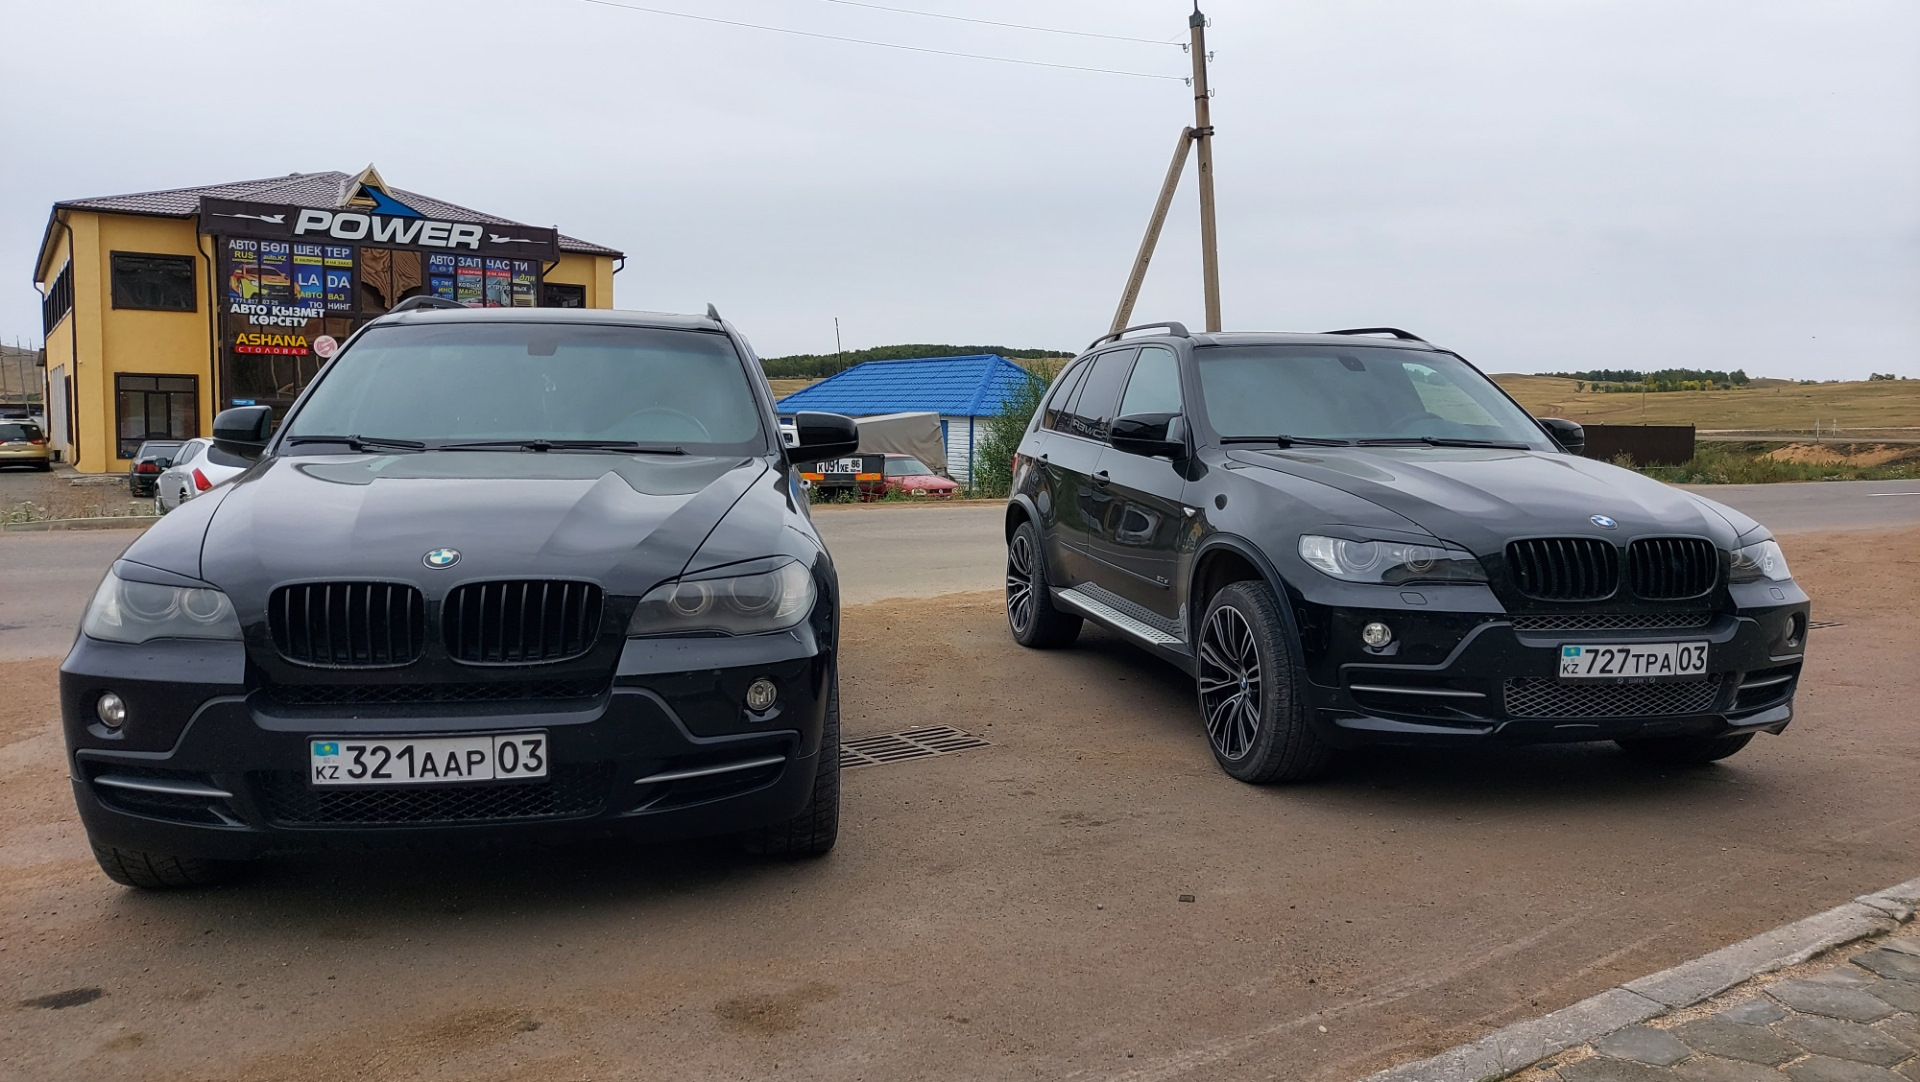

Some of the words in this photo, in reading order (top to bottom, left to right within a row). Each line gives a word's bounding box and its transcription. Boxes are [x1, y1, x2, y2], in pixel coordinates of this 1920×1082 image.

[293, 207, 484, 250] POWER
[229, 239, 257, 251] АВТО
[261, 242, 289, 253] БӨЛ
[294, 244, 322, 256] ШЕК
[325, 247, 350, 258] ТЕР
[429, 255, 455, 266] АВТО
[458, 257, 481, 269] ЗАП
[486, 259, 511, 270] ЧАС
[513, 261, 528, 272] ТИ
[230, 303, 267, 316] АВТО
[271, 305, 326, 319] ҚЫЗМЕТ
[249, 316, 309, 328] КӨРСЕТУ
[235, 332, 308, 348] ASHANA
[238, 347, 309, 355] СТОЛОВАЯ
[851, 459, 861, 468] 86
[1585, 648, 1672, 675] 727TPA
[1678, 645, 1706, 672] 03
[1562, 663, 1580, 675] KZ
[345, 744, 486, 779] 321AAP
[497, 738, 544, 774] 03
[315, 765, 340, 780] KZ
